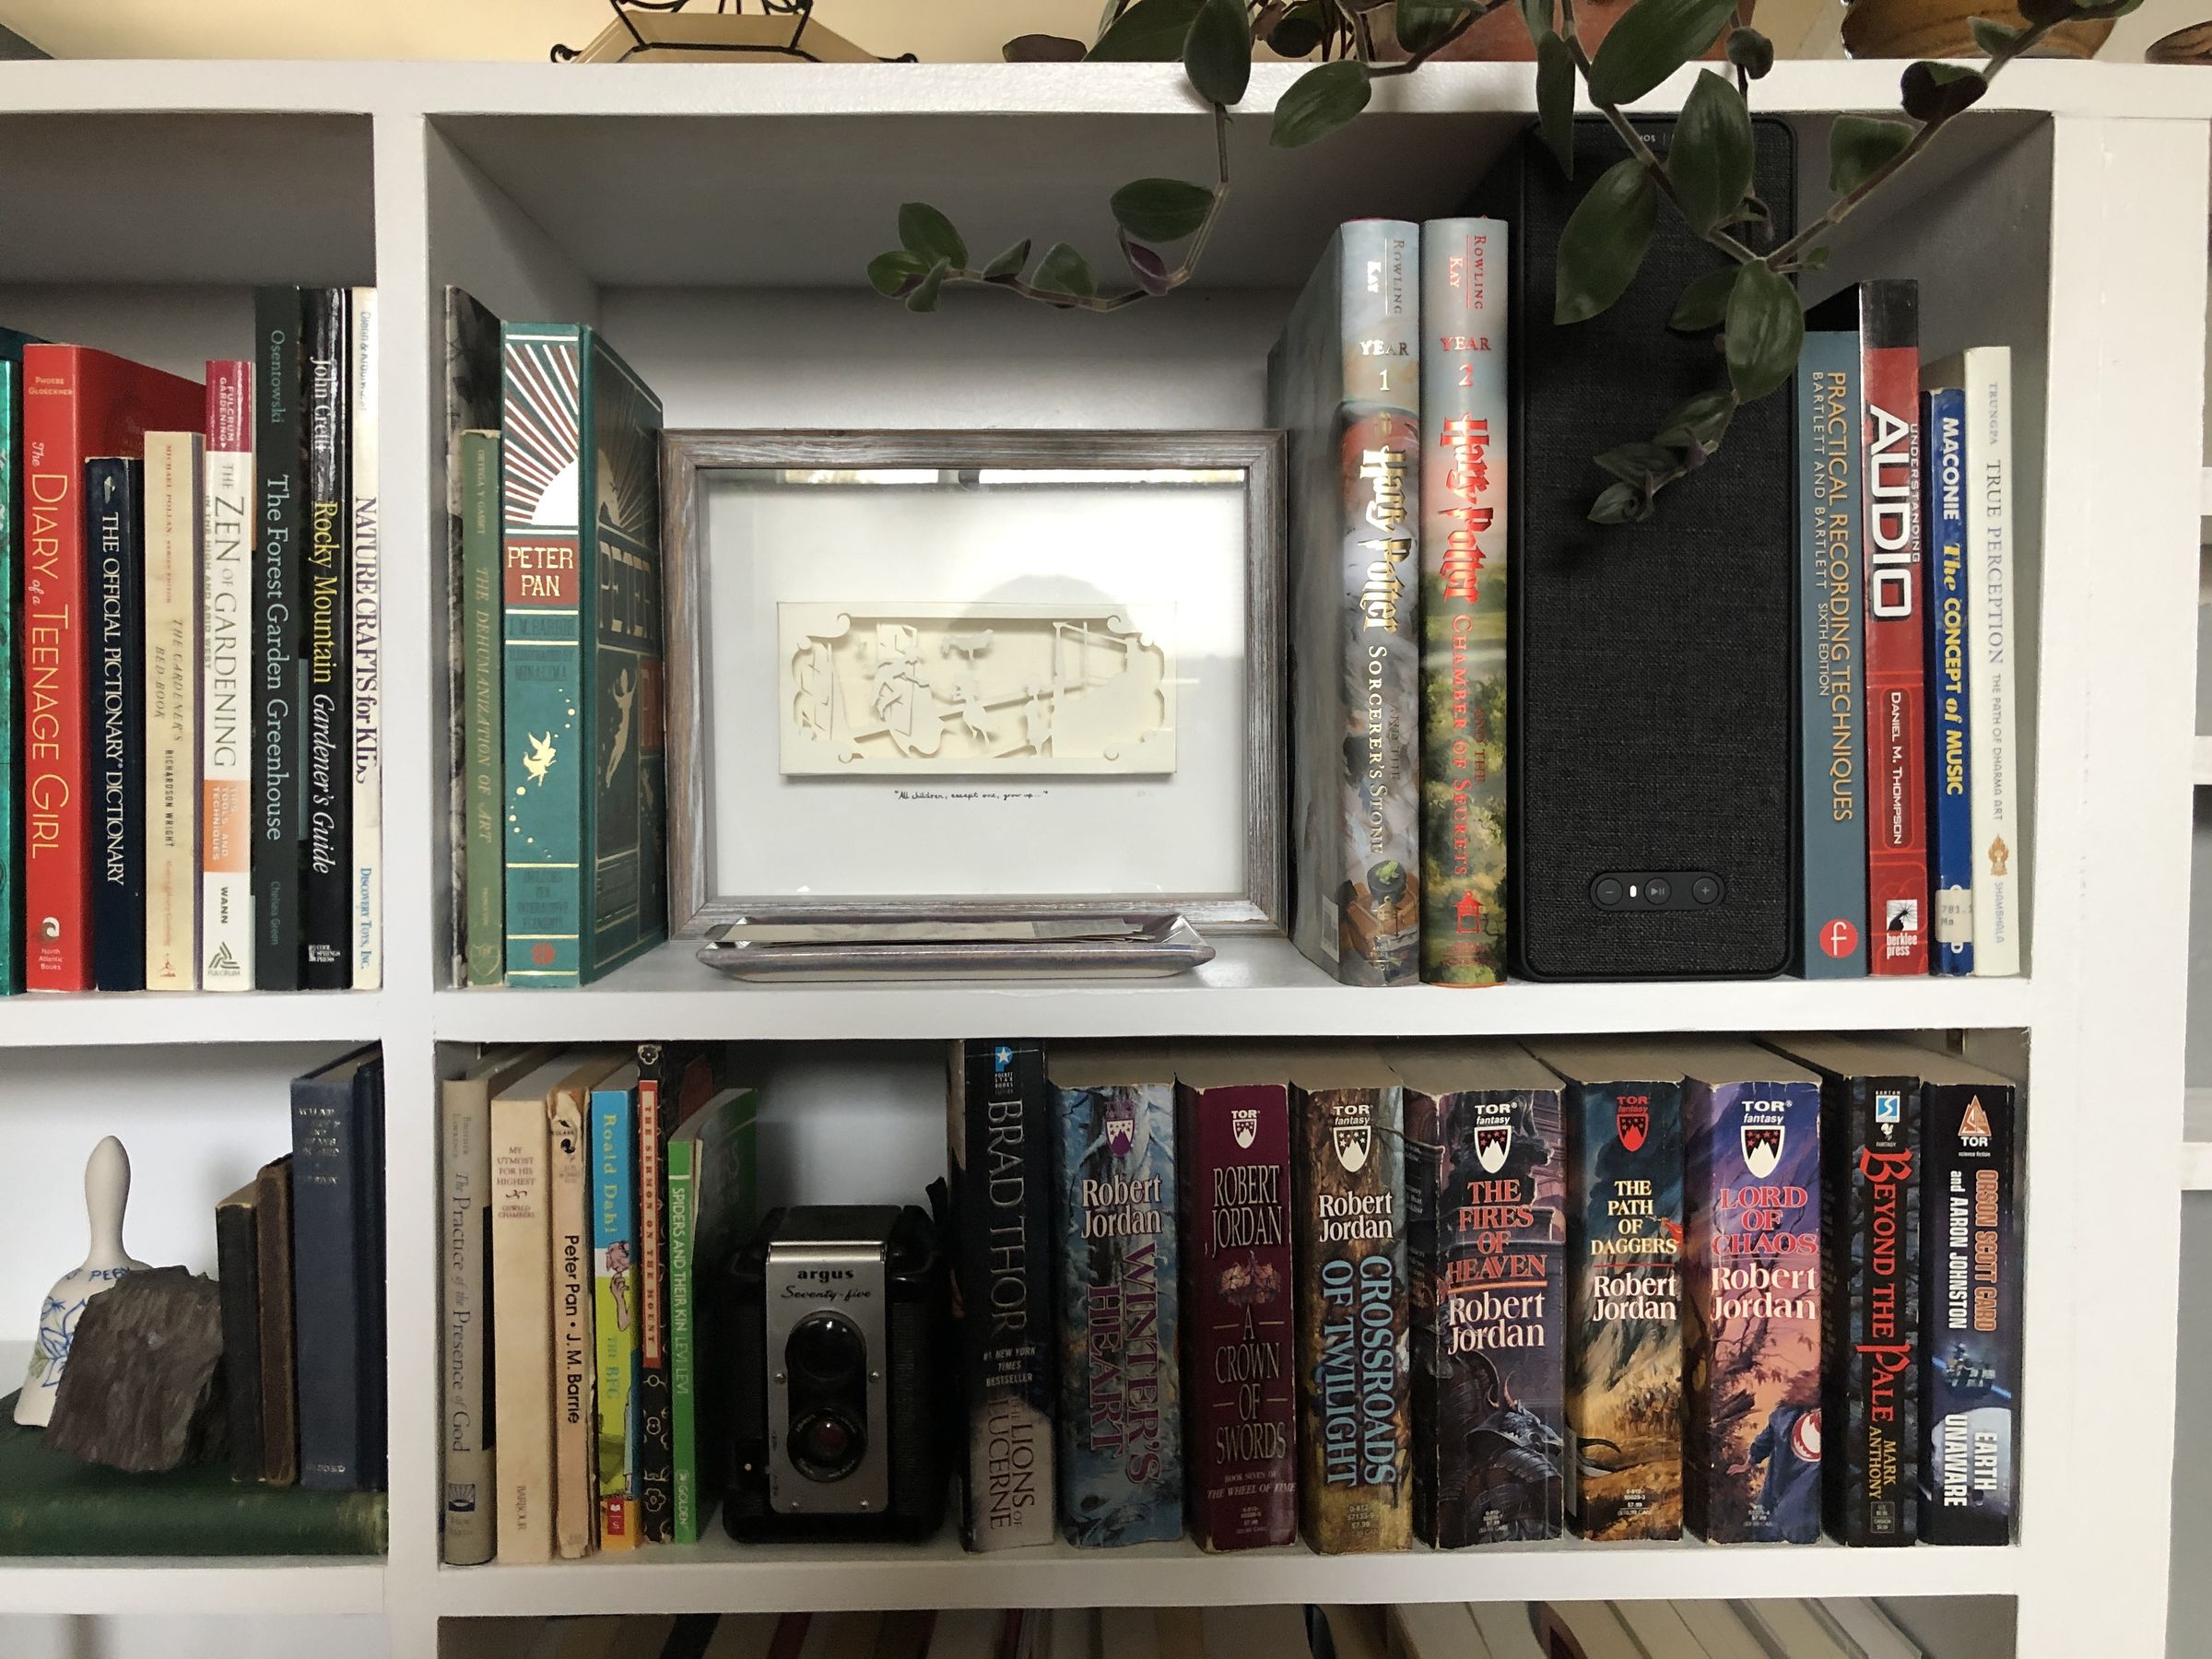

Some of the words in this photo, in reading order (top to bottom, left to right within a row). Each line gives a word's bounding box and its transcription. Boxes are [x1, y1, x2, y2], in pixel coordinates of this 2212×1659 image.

[1367, 260, 1382, 293] KAY
[1393, 239, 1405, 314] ROWLING
[1449, 257, 1463, 288] KAY
[1475, 235, 1487, 310] ROWLING
[1359, 339, 1409, 356] YEAR
[1441, 336, 1491, 351] YEAR
[35, 376, 65, 385] PHOEBE
[271, 330, 286, 423] Osentowski
[1379, 369, 1390, 391] 1
[1458, 362, 1474, 387] 2
[1812, 372, 1825, 453] BARTLETT
[1988, 382, 1999, 445] TRUNGPA
[1440, 413, 1490, 506] Harry
[1827, 372, 1847, 506] PRACTICAL
[1358, 445, 1408, 533] Harry
[1813, 462, 1825, 499] AND
[1910, 423, 1921, 563] UNDERSTANDING
[1941, 418, 1959, 520] MACONIE
[1986, 460, 2002, 517] TRUE
[267, 475, 289, 521] The
[1870, 404, 1912, 618] AUDIO
[32, 474, 68, 580] DIARY
[102, 512, 119, 553] THE
[214, 496, 244, 562] ZEN
[308, 502, 339, 568] Rocky
[355, 498, 378, 594] NATURE
[1814, 507, 1826, 590] BARTLETT
[267, 527, 289, 598] Forest
[507, 547, 573, 570] PETER
[1438, 507, 1494, 604] Potter
[1942, 542, 1961, 591] The
[103, 558, 122, 643] OFFICIAL
[521, 575, 561, 596] PAN
[1357, 537, 1412, 634] Potter
[1829, 512, 1851, 660] RECORDING
[1987, 527, 2004, 664] PERCEPTION
[266, 604, 289, 689] Garden
[313, 576, 337, 683] Mountain
[356, 597, 378, 691] CRAFTS
[1817, 604, 1828, 640] SIXTH
[1944, 596, 1962, 694] CONCEPT
[32, 605, 69, 759] TEENAGE
[155, 647, 166, 719] BED-BOOK
[214, 593, 237, 767] GARDENING
[477, 610, 490, 765] DEHUMANIZATION
[1452, 614, 1473, 730] CHAMBER
[1818, 643, 1829, 697] EDITION
[1993, 673, 2002, 694] THE
[356, 695, 378, 724] for
[1368, 646, 1387, 779] SORCERER'S
[1890, 692, 1902, 741] DANIEL
[1944, 698, 1962, 724] of
[1993, 698, 2003, 724] PATH
[312, 694, 335, 813] Gardener's
[1453, 740, 1467, 769] OF
[1829, 665, 1853, 821] TECHNIQUES
[1993, 728, 2003, 743] OF
[164, 749, 173, 808] RICHARDSON
[267, 699, 289, 841] Greenhouse
[1946, 730, 1963, 795] MUSIC
[1993, 747, 2004, 796] DHARMA
[32, 774, 69, 859] GIRL
[951, 792, 978, 801] except
[1003, 793, 1021, 801] grow
[1370, 783, 1387, 853] STONE
[1891, 766, 1903, 844] THOMPSON
[1994, 800, 2004, 820] ART
[106, 771, 124, 886] DICTIONARY
[165, 812, 174, 849] WRIGHT
[312, 820, 335, 874] Guide
[1453, 779, 1473, 876] SECRETS
[1887, 946, 1910, 959] press
[1231, 1110, 1258, 1119] TOR
[1333, 1105, 1371, 1116] TOR
[1335, 1116, 1371, 1126] fantasy
[1475, 1104, 1512, 1114] TOR
[1476, 1115, 1512, 1125] fantasy
[1617, 1095, 1649, 1105] TOR
[1741, 1100, 1785, 1112] TOR
[1743, 1113, 1783, 1124] fantasy
[603, 1113, 618, 1174] Roald
[987, 1099, 1025, 1207] BRAD
[1960, 1136, 1988, 1147] TOR
[1081, 1173, 1161, 1208] Robert
[1213, 1165, 1280, 1207] ROBERT
[1319, 1191, 1393, 1218] Robert
[1466, 1179, 1523, 1205] THE
[1613, 1180, 1653, 1196] THE
[1720, 1186, 1807, 1210] LORD
[1950, 1171, 1967, 1192] and
[1974, 1170, 1999, 1227] ORSON
[604, 1184, 618, 1234] Dahl
[672, 1187, 685, 1238] SPIDERS
[1080, 1206, 1161, 1239] Jordan
[1212, 1206, 1282, 1258] JORDAN
[1319, 1216, 1394, 1242] Jordan
[1459, 1204, 1535, 1231] FIRES
[1607, 1199, 1654, 1216] PATH
[1618, 1219, 1644, 1235] OF
[1741, 1208, 1783, 1231] OF
[1859, 1147, 1913, 1276] BEYOND
[1949, 1196, 1969, 1247] AARON
[453, 1196, 472, 1270] Practice
[564, 1235, 580, 1279] Peter
[673, 1240, 685, 1268] AND
[1477, 1230, 1512, 1255] OF
[1591, 1239, 1678, 1255] DAGGERS
[1711, 1231, 1818, 1255] CHAOS
[1974, 1230, 1998, 1282] SCOTT
[674, 1272, 687, 1306] THEIR
[797, 1269, 853, 1283] argus
[989, 1216, 1027, 1337] THOR
[1321, 1259, 1355, 1307] OF
[1447, 1254, 1548, 1285] HEAVEN
[1594, 1272, 1677, 1298] Robert
[1712, 1262, 1816, 1291] Robert
[1948, 1252, 1968, 1329] JOHNSTON
[565, 1285, 580, 1315] Pan
[674, 1309, 687, 1332] KIN
[1242, 1304, 1255, 1340] A
[1449, 1291, 1546, 1327] Robert
[1593, 1296, 1677, 1322] Jordan
[1710, 1292, 1816, 1322] Jordan
[1871, 1284, 1896, 1338] THE
[1973, 1287, 1998, 1332] CARD
[452, 1311, 470, 1390] Presence
[1447, 1318, 1546, 1356] Jordan
[1088, 1284, 1125, 1458] HEART
[1123, 1241, 1162, 1485] WINTER'S
[1216, 1343, 1280, 1383] CROWN
[1359, 1255, 1397, 1486] CROSSROADS
[1854, 1343, 1912, 1422] PALE
[567, 1374, 582, 1424] Barrie
[1239, 1383, 1261, 1421] OF
[1322, 1316, 1358, 1488] TWILIGHT
[452, 1411, 470, 1453] God
[1217, 1422, 1288, 1465] SWORDS
[1010, 1423, 1035, 1509] LIONS
[1867, 1426, 1883, 1499] ANTHONY
[1884, 1440, 1897, 1485] MARK
[1944, 1414, 1967, 1507] UNAWARE
[1975, 1431, 1997, 1490] EARTH
